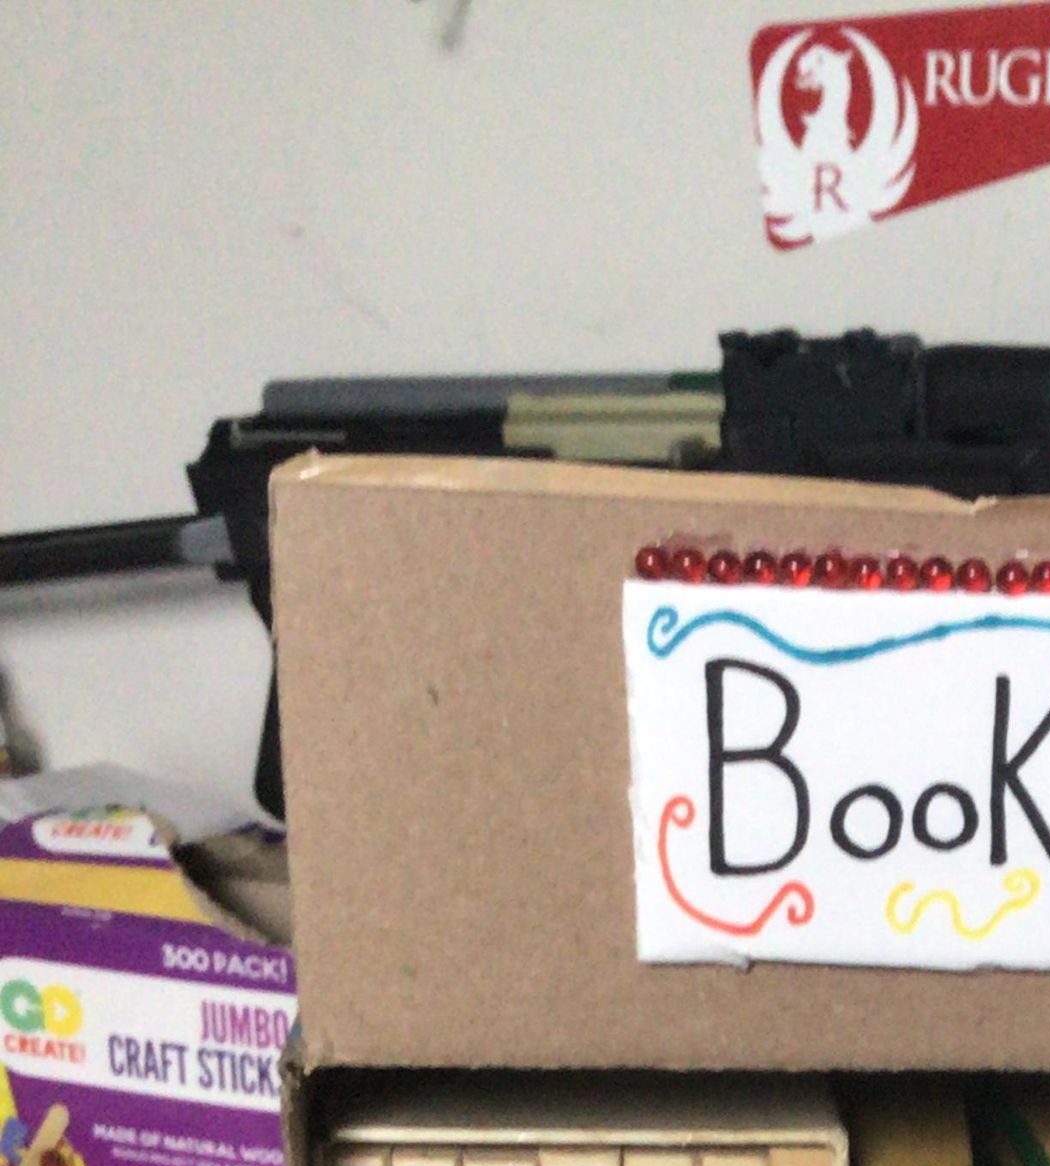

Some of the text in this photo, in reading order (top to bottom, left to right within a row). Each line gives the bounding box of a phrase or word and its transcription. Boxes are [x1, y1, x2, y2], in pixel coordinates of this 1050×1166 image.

[811, 163, 848, 212] R
[201, 1000, 289, 1051] JUMBO
[108, 1034, 283, 1098] CRAFT STICK
